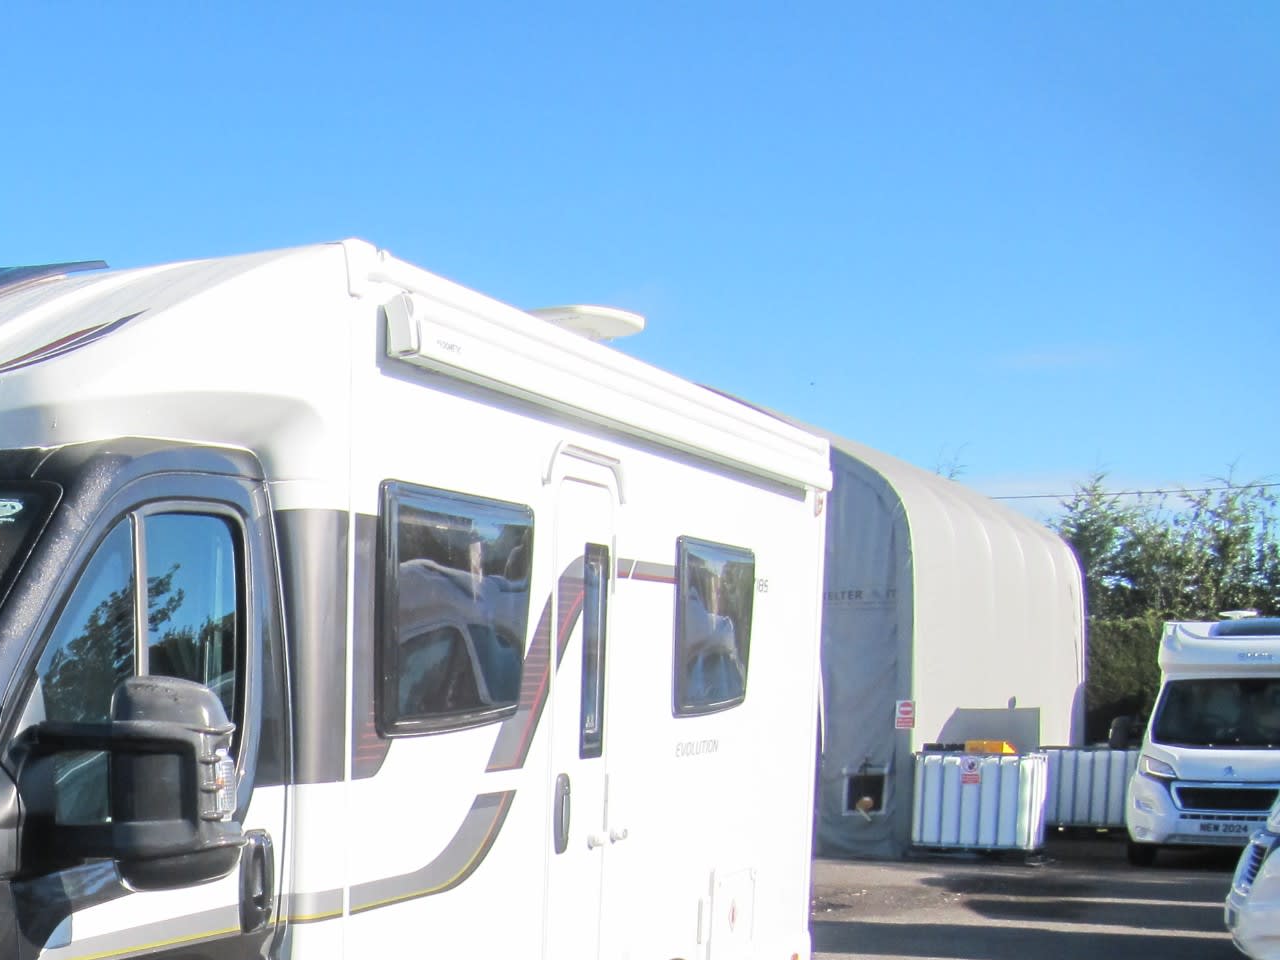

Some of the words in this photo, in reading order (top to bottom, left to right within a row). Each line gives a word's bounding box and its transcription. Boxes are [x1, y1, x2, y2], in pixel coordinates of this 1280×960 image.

[675, 739, 719, 758] EVOLUTION
[1200, 822, 1219, 832] NEW
[1222, 823, 1249, 833] 2024
